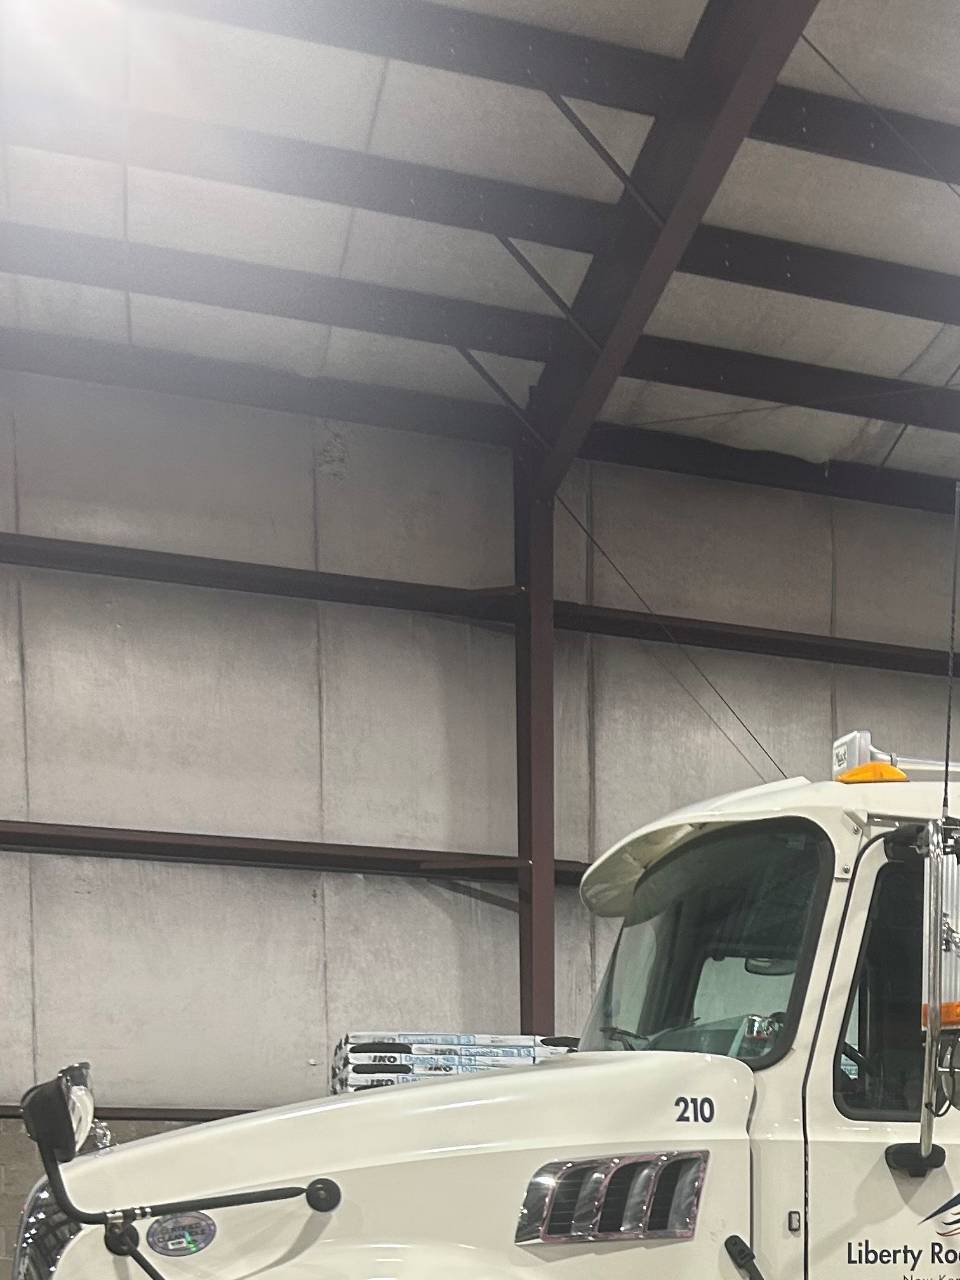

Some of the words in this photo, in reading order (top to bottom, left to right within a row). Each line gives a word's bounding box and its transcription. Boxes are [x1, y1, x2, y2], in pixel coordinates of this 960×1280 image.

[372, 1055, 397, 1063] IKO
[674, 1096, 715, 1123] 210
[847, 1240, 922, 1271] Liberty
